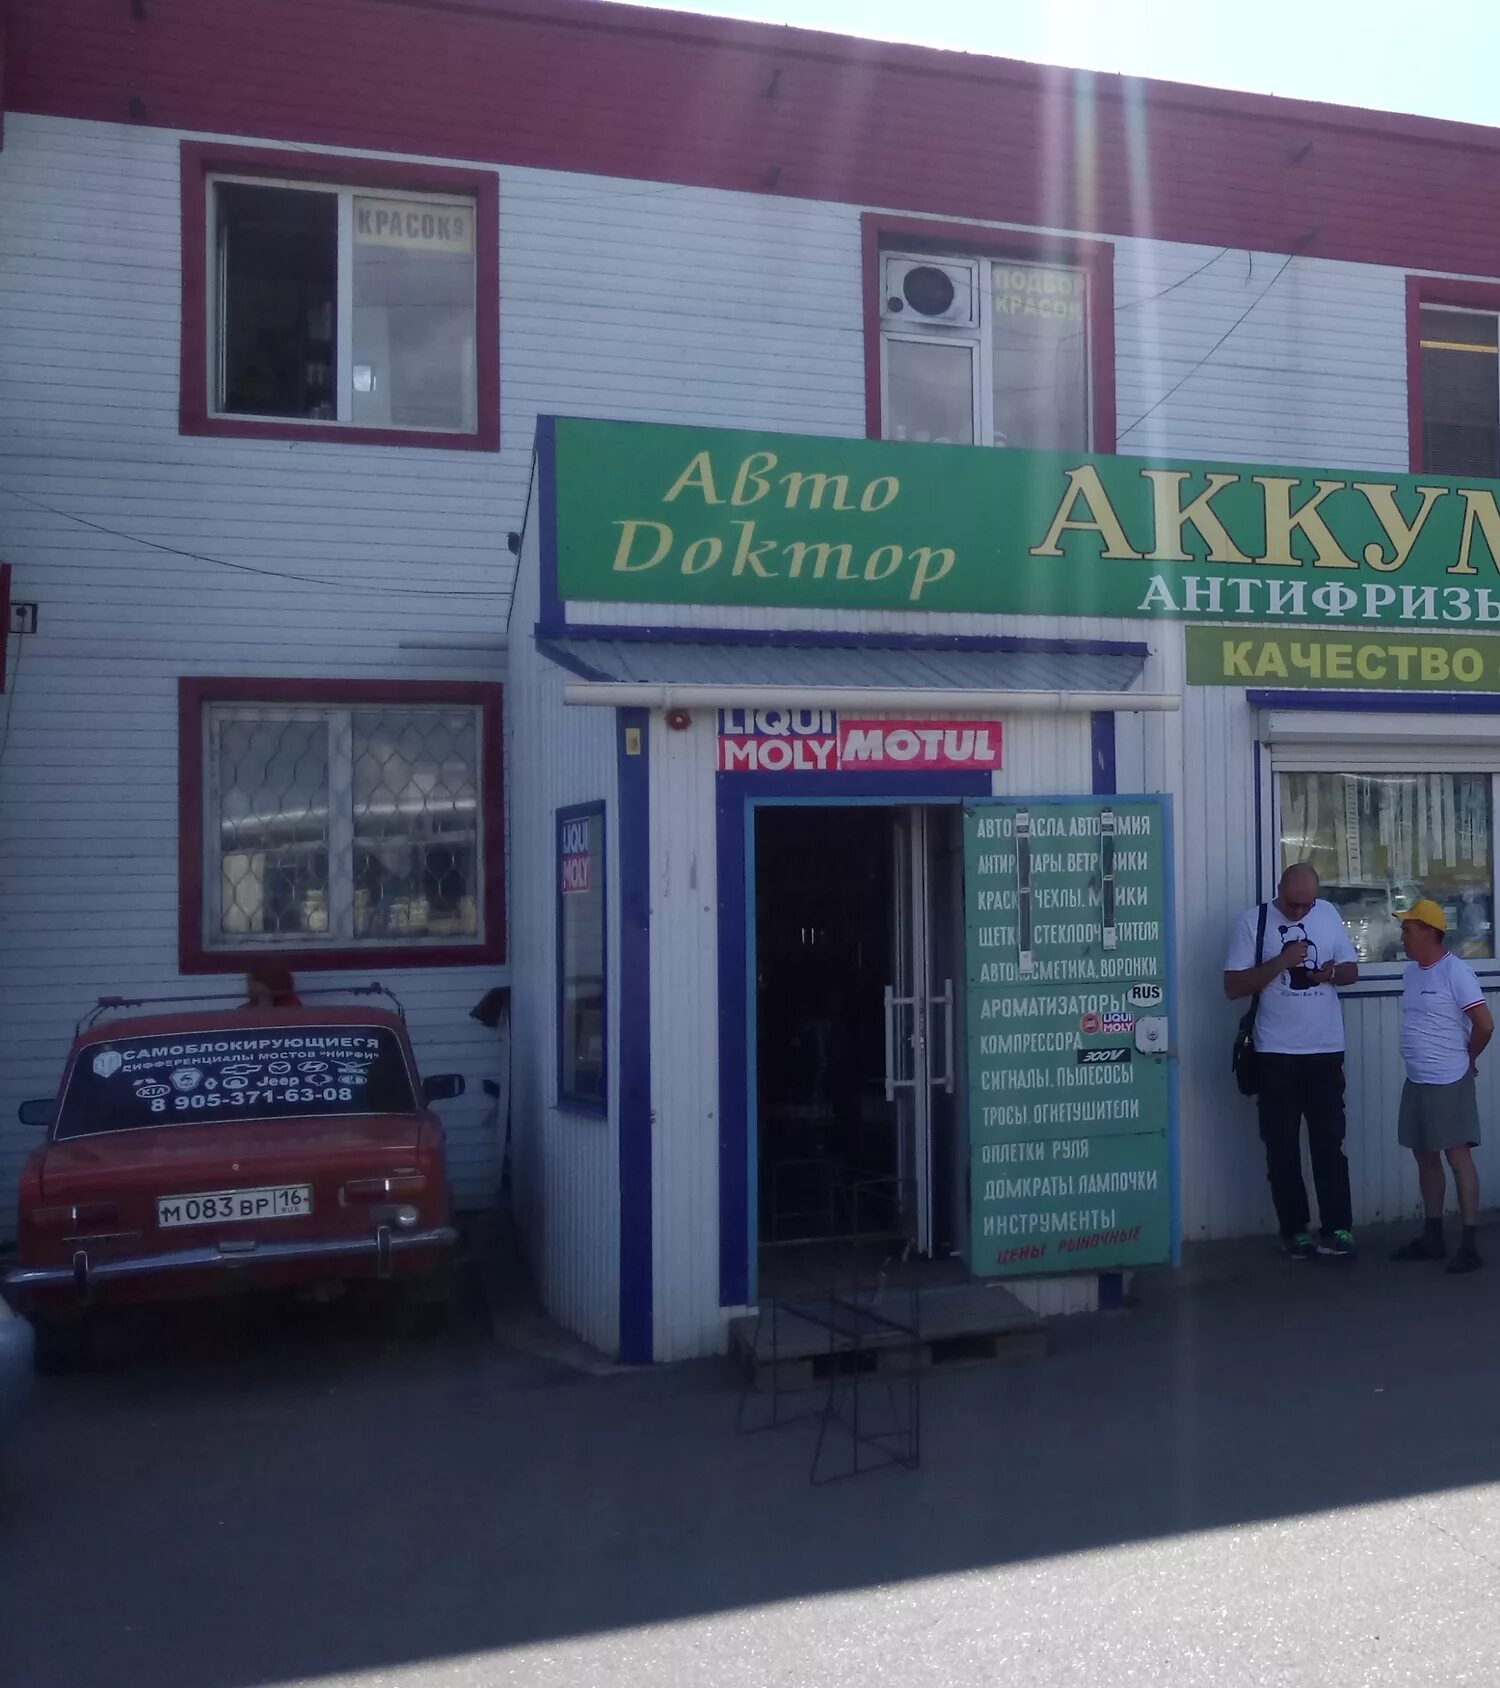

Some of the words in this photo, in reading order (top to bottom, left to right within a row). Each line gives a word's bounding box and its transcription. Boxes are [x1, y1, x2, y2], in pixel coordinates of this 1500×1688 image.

[663, 450, 900, 513] Авто
[1221, 641, 1484, 683] КАЧЕСТВО
[724, 708, 834, 735] LIQUI
[842, 719, 995, 762] MOTUL
[724, 739, 836, 771] MOLY
[563, 820, 589, 854] LIQUI
[977, 817, 1067, 839] АВТОАСЛА,
[1069, 815, 1150, 837] АВТОМИЯ
[563, 856, 590, 891] MOLY
[978, 854, 1065, 875] АНТИРАРЫ.
[1067, 851, 1148, 873] ВЕТРИКИ
[978, 926, 1018, 948] ЩЕТК
[1034, 921, 1159, 945] СТЕКЛООЧТИТЕЛЯ
[1101, 956, 1157, 977] ВОРОНКИ
[1132, 986, 1160, 999] RUS
[980, 993, 1126, 1019] АРОМАТИЗАТОРЫ
[1103, 1013, 1132, 1023] LIQUI
[1103, 1022, 1134, 1033] MOLY
[122, 1037, 379, 1061] САМОБЛОКИРУЮЩИЕСЯ
[980, 1031, 1084, 1055] КОМПРЕССОРА
[122, 1052, 255, 1073] ДИФФЕРЕНЦИАЛЫ
[258, 1051, 316, 1061] МОСТОВ
[1082, 1049, 1126, 1062] 300V
[256, 1075, 300, 1087] Jeep
[1056, 1064, 1134, 1087] ПЫЛЕСОСЫ
[140, 1086, 167, 1097] KIA
[150, 1097, 166, 1113] 8
[174, 1087, 353, 1111] 905-371-63-08
[1033, 1099, 1140, 1124] ОГНЕТУШИТЕЛИ
[981, 1141, 1045, 1164] ОПЛЕТКИ
[1052, 1138, 1089, 1160] РУЛЯ
[1077, 1170, 1158, 1195] ЛАМПОЧКИ
[278, 1189, 302, 1207] 16
[983, 1208, 1116, 1237] ИНСТРУМЕНТЫ
